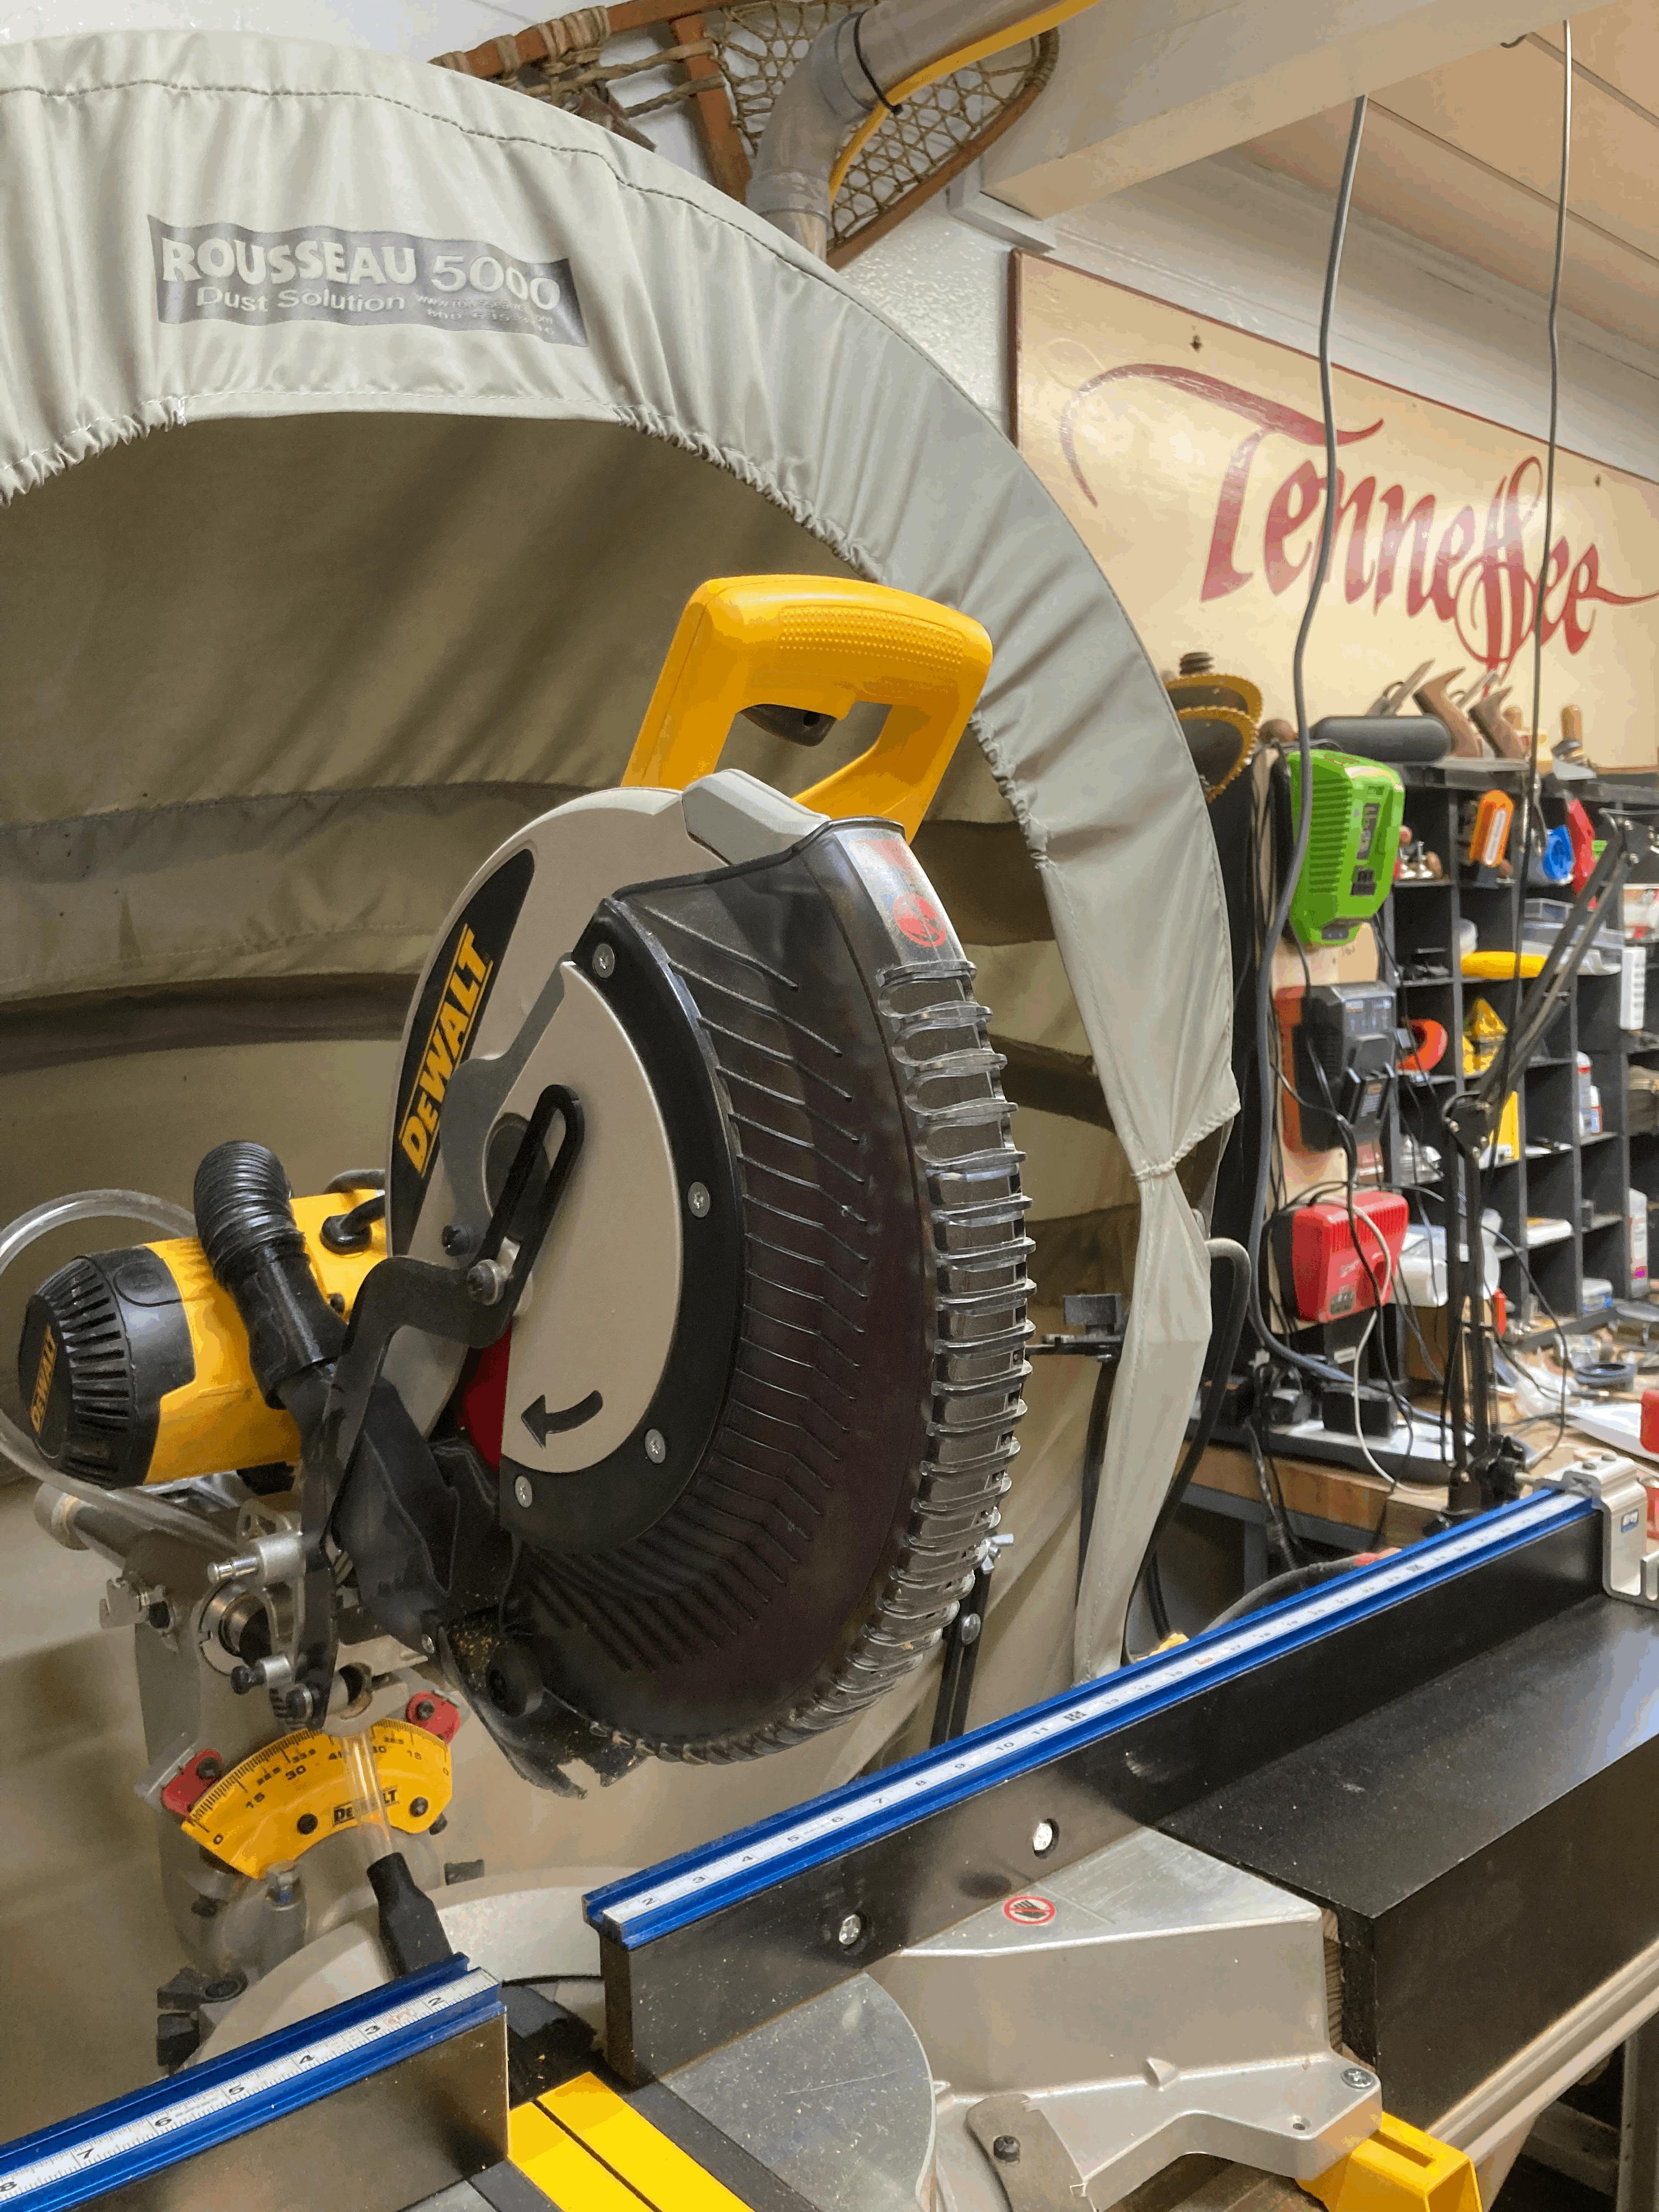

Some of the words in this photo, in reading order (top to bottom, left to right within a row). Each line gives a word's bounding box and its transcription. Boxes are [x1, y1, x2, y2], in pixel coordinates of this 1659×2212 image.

[162, 236, 416, 286] ROUSSEAU
[431, 255, 561, 311] 5000
[196, 286, 268, 312] Dust
[278, 290, 405, 313] Solution
[400, 927, 487, 1175] DEWALT
[995, 1741, 1014, 1751] 10
[77, 2148, 94, 2160] 7
[154, 2117, 172, 2128] 6
[228, 2085, 245, 2095] 5
[299, 2055, 315, 2065] 4
[365, 2025, 381, 2035] 3
[428, 1996, 444, 2006] 2
